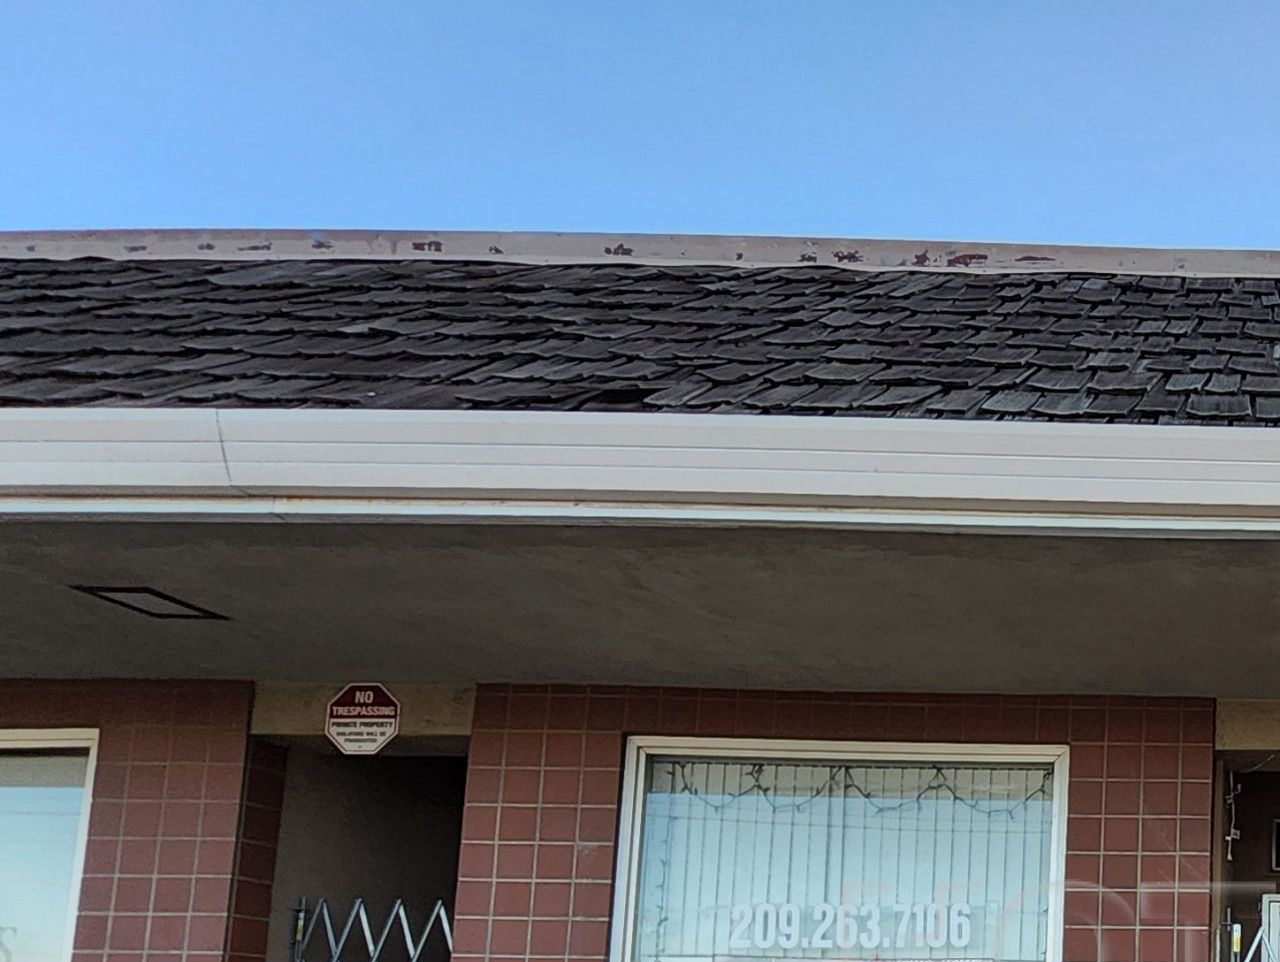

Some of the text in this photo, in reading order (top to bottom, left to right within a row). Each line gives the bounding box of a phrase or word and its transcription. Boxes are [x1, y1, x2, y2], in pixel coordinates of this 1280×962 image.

[354, 691, 374, 704] NO
[332, 706, 396, 716] TRESPASSING
[729, 903, 972, 949] 209.263.7106
